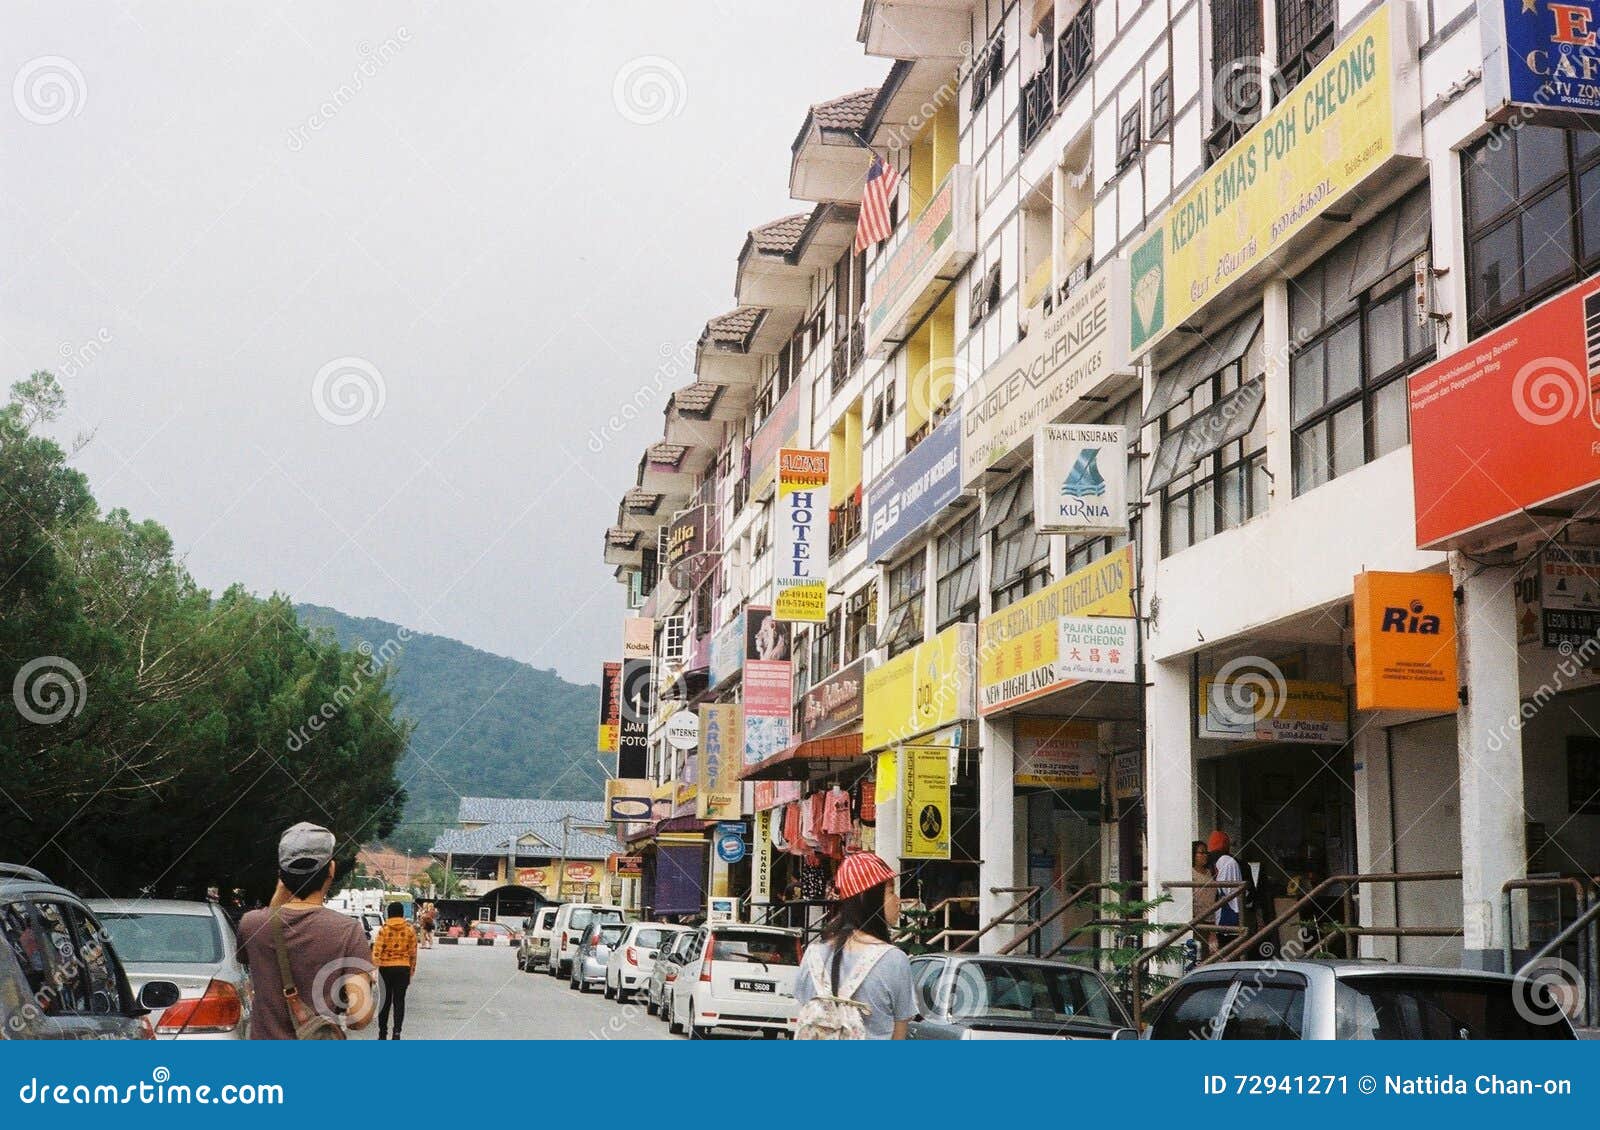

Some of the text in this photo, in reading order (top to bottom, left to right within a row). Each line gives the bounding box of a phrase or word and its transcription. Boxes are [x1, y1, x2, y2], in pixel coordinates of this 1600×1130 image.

[1547, 3, 1597, 47] E
[1544, 80, 1572, 96] KTV
[1171, 186, 1209, 254] KEDAI
[1215, 144, 1257, 217] EMAS
[1264, 106, 1297, 173] POH
[1304, 35, 1377, 135] CHEONG
[1018, 386, 1064, 432] REMITTANCE
[1065, 351, 1103, 395] SERVICES
[1048, 429, 1119, 444] WAKIL INSURANS
[780, 474, 828, 487] BUDGET
[1059, 497, 1111, 524] KURNIA
[791, 491, 814, 578] HOTEL
[1062, 558, 1124, 618] HIGHLANDS
[1063, 622, 1128, 636] PAJAK GADAI
[1381, 599, 1441, 636] Ria
[626, 642, 650, 651] Kodak
[1066, 633, 1125, 648] TAI CHEONG
[985, 686, 1001, 706] NEW
[1002, 663, 1056, 702] HIGHLANDS
[620, 736, 647, 747] FOTO
[624, 722, 645, 733] JAM
[706, 709, 721, 789] FARMASI
[760, 810, 769, 894] MONEY CHANGER
